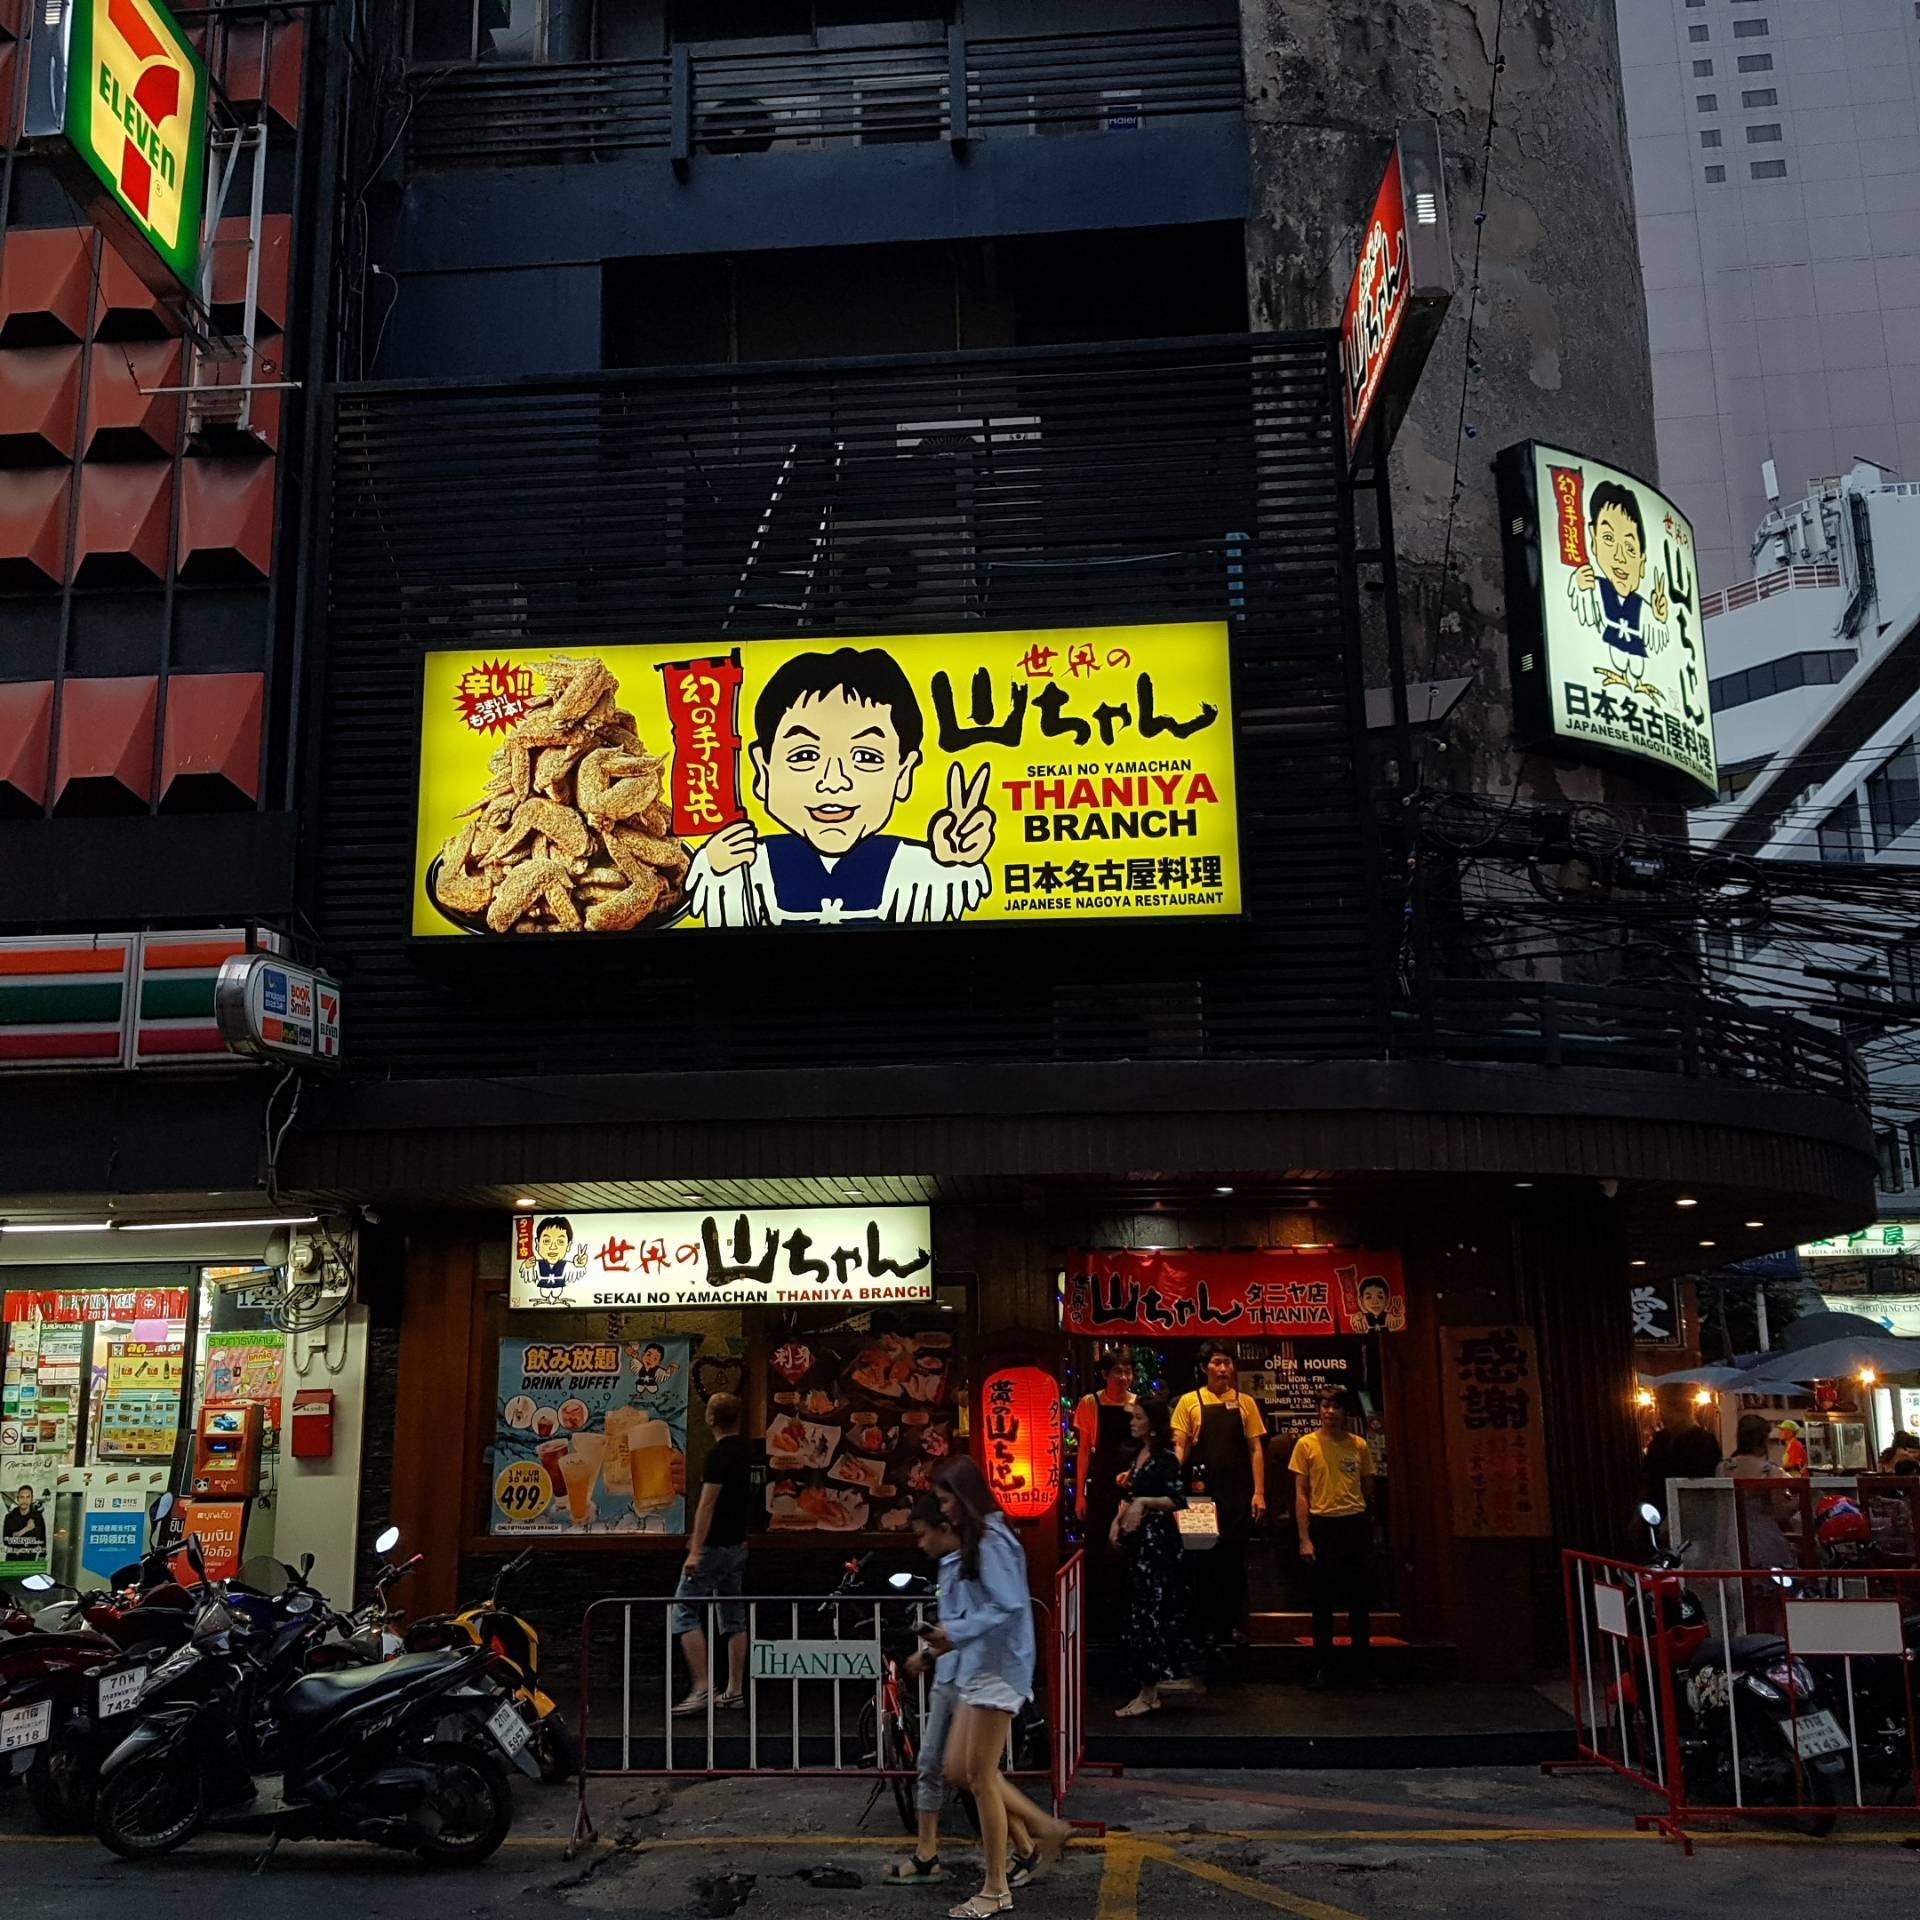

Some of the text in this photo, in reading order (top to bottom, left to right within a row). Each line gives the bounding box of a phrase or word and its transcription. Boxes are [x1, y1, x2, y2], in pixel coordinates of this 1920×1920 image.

[1016, 642, 1131, 679] 世界の
[930, 666, 1219, 754] 山ちゃん
[1563, 681, 1714, 772] 日本名古屋料理
[1565, 718, 1630, 743] JAPANESE
[1631, 733, 1673, 758] NAGOYA
[679, 672, 724, 827] 幻の手羽先
[1026, 759, 1192, 778] SEKAI NO YAMACHAN
[1002, 772, 1220, 812] THANIYA
[1023, 809, 1198, 843] BRANCH
[1003, 855, 1224, 894] 日本名古屋料理
[1004, 891, 1224, 911] JAPANESE NAGOYA RESTAURANT
[290, 998, 311, 1017] Smile
[593, 1212, 933, 1288] 世界の 山ちゃん
[592, 1284, 931, 1305] SEKAI NO YAMACHAN THANIYA BRANCH
[1090, 1270, 1245, 1330] 山ちゃん
[1246, 1282, 1330, 1306] タニヤ店
[1247, 1305, 1333, 1325] THANIYA
[526, 1347, 617, 1372] 飲み放題
[1264, 1358, 1348, 1370] OPEN HOURS
[521, 1375, 620, 1390] DRINK BUFFET
[1288, 1375, 1307, 1383] MON
[1312, 1375, 1326, 1383] FRI
[89, 1534, 136, 1545] 扫码领红包
[6, 1730, 40, 1747] 5118
